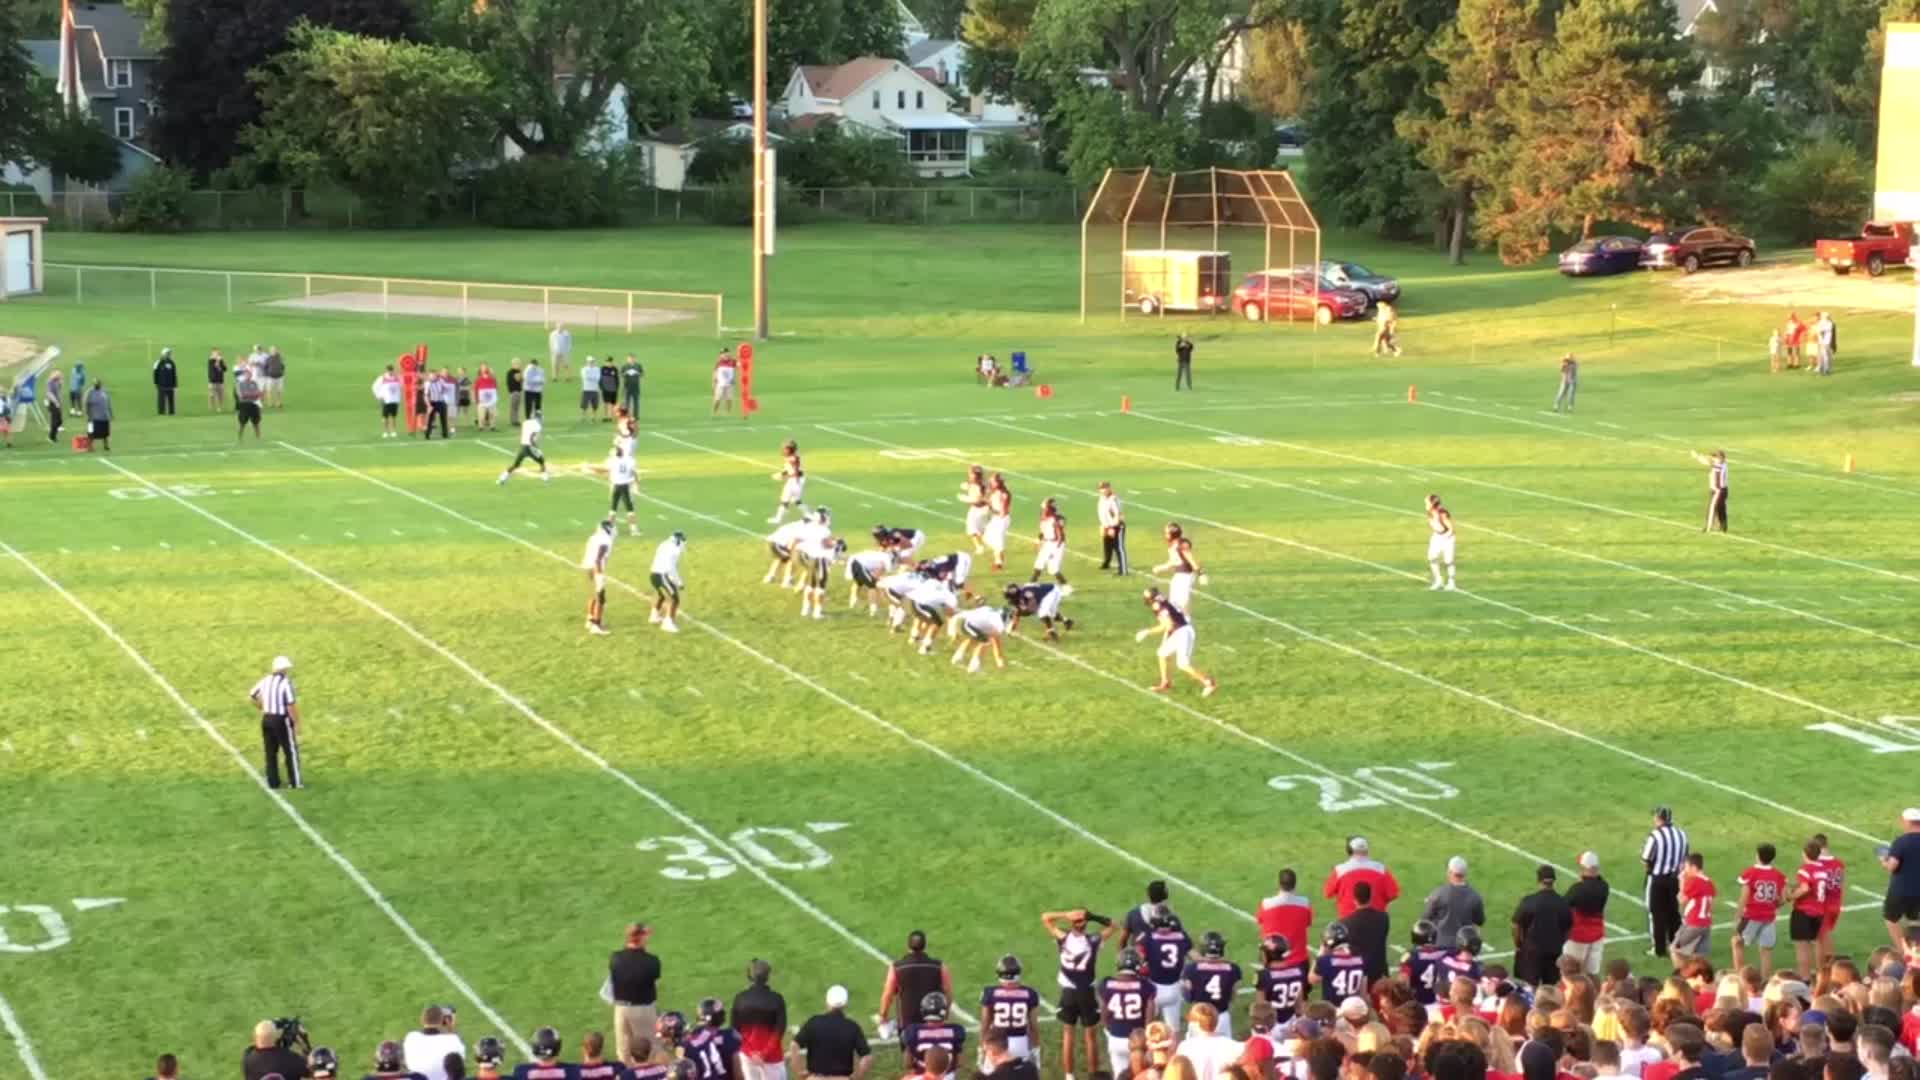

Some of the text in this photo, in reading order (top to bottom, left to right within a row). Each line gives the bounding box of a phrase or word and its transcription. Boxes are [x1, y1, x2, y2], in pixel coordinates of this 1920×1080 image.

[1267, 765, 1460, 812] 20
[636, 826, 832, 880] 30
[1060, 945, 1092, 971] 27
[1160, 943, 1179, 968] 3
[1205, 974, 1222, 1000] 4
[1271, 982, 1302, 1009] 39
[1332, 969, 1363, 996] 40
[993, 1002, 1028, 1028] 29
[1107, 993, 1142, 1020] 42
[699, 1041, 727, 1078] 14
